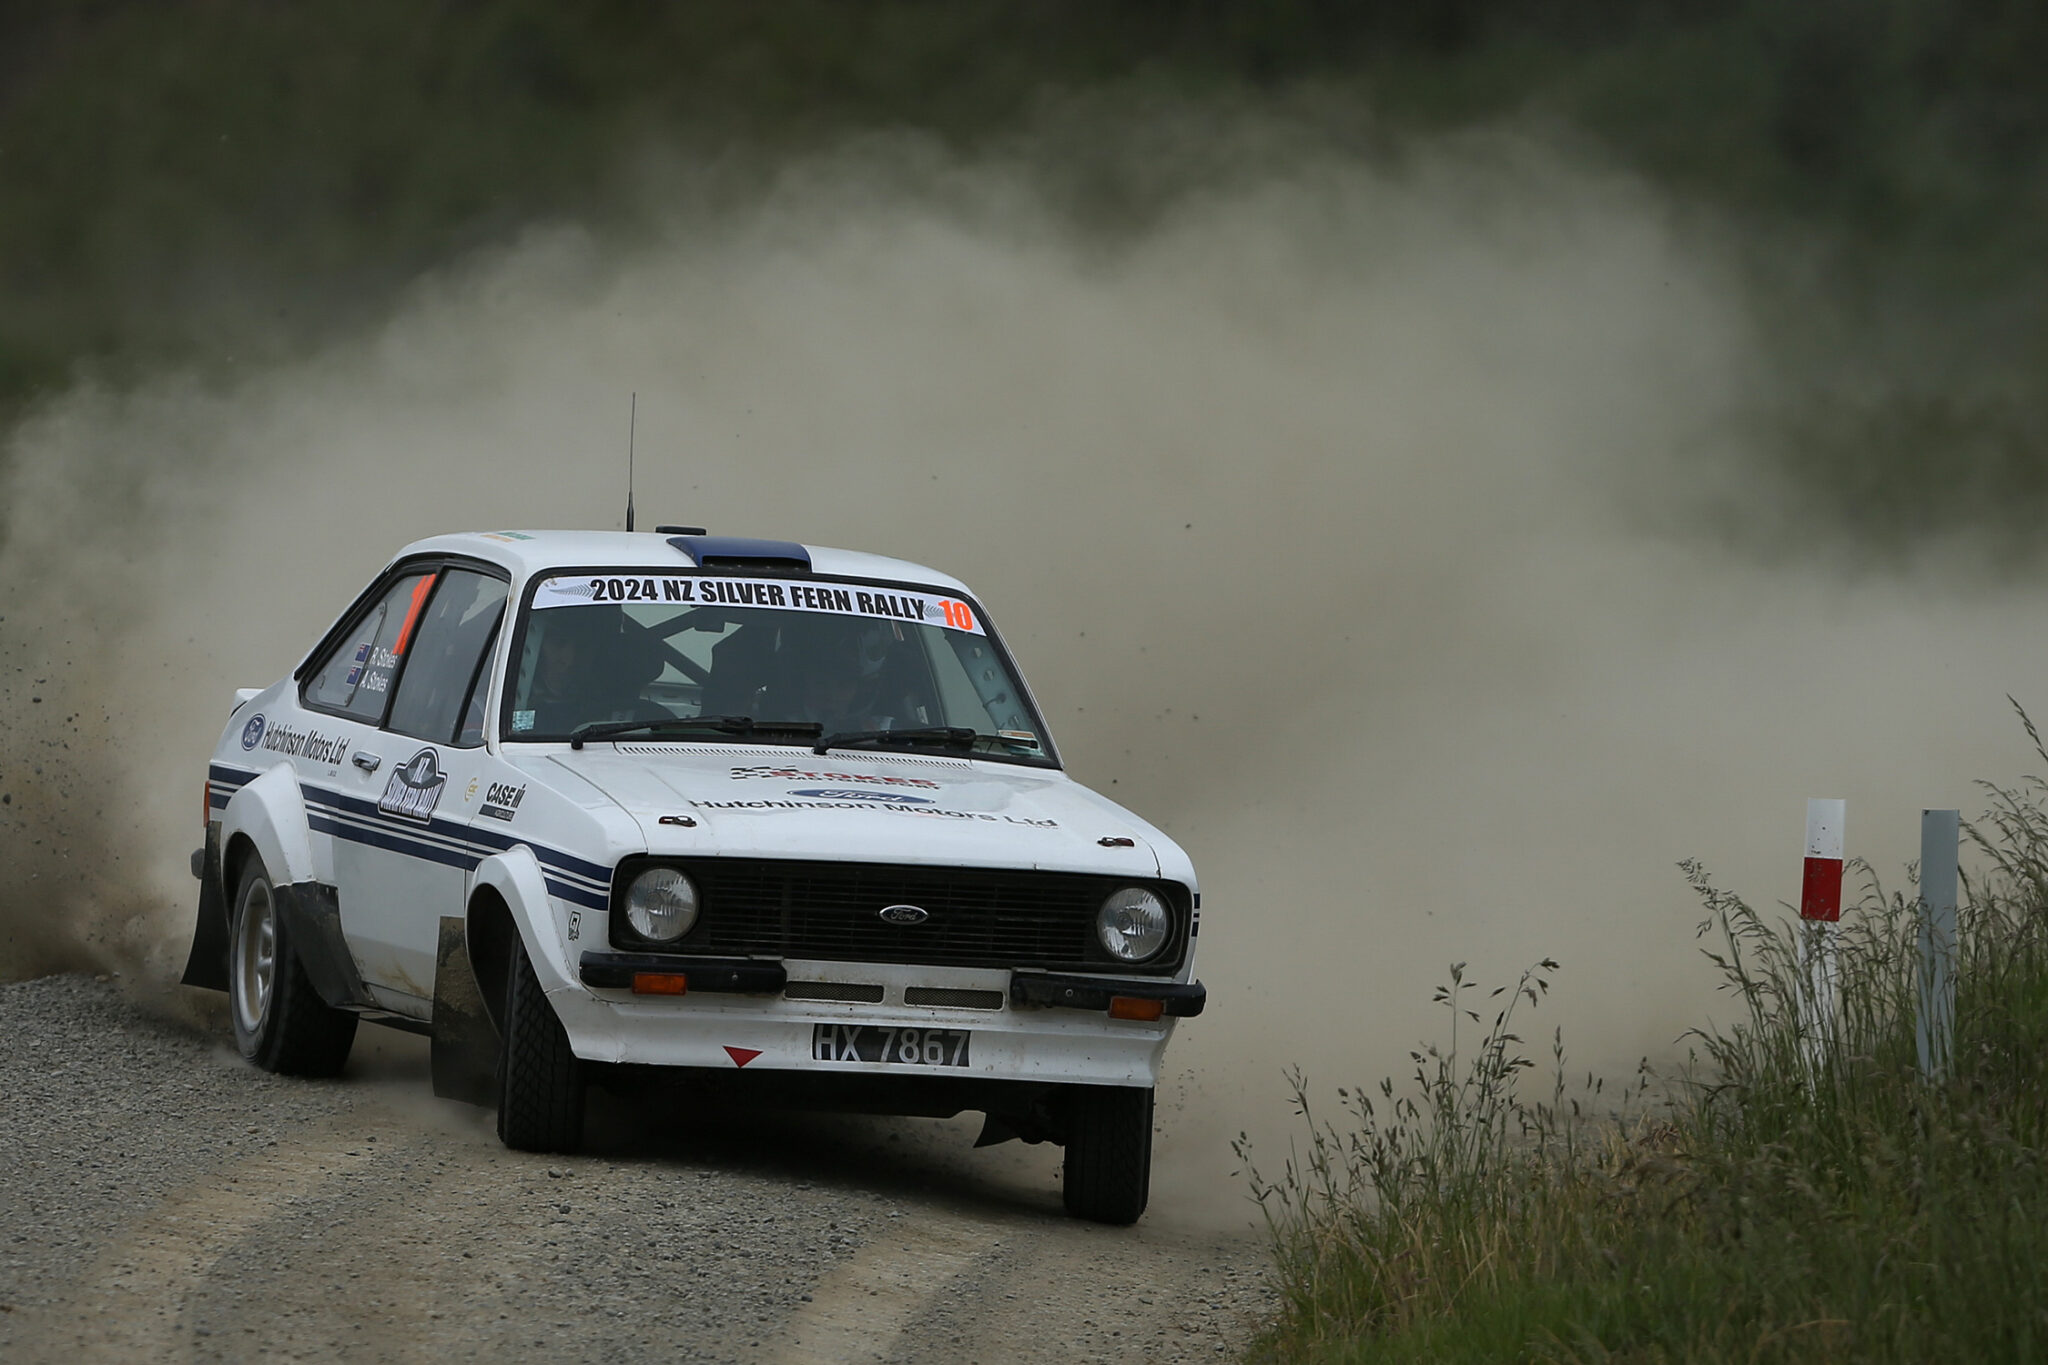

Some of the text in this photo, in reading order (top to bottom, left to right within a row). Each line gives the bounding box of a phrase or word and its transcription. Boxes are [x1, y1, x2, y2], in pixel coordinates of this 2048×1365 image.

[590, 578, 925, 620] 2024 NZ SILVER FERN RALLY
[938, 599, 974, 631] 10
[261, 720, 351, 765] Hutchinson Motors Ltd
[769, 770, 937, 786] STOKES
[486, 782, 517, 806] CASE
[818, 790, 904, 802] Ford
[689, 799, 877, 809] Hutchinson
[883, 803, 997, 821] Motors
[1003, 815, 1059, 827] Ltd
[890, 907, 919, 922] Ford
[815, 1024, 969, 1067] HX 7867
